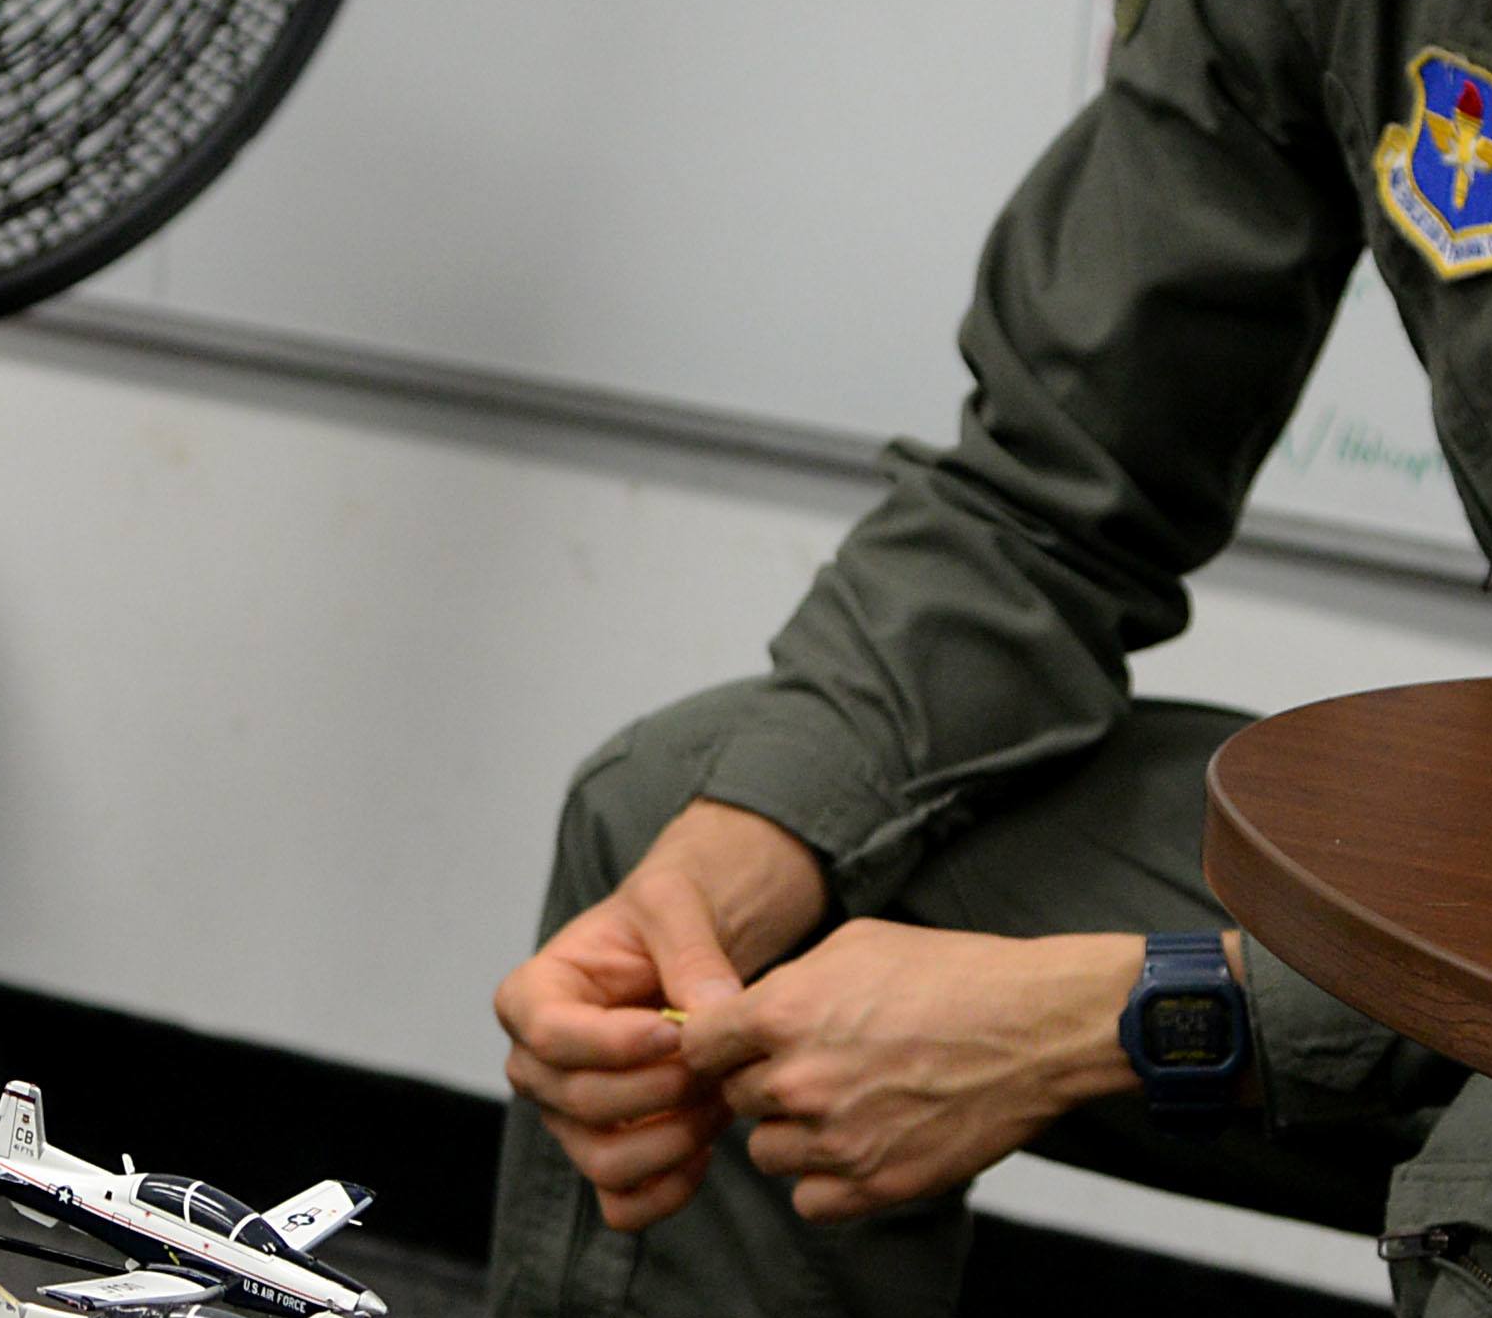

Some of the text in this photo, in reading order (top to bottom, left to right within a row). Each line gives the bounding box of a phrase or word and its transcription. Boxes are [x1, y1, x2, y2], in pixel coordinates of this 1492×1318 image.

[15, 1127, 34, 1145] CB
[243, 1279, 308, 1314] U.S. AIR FORCE
